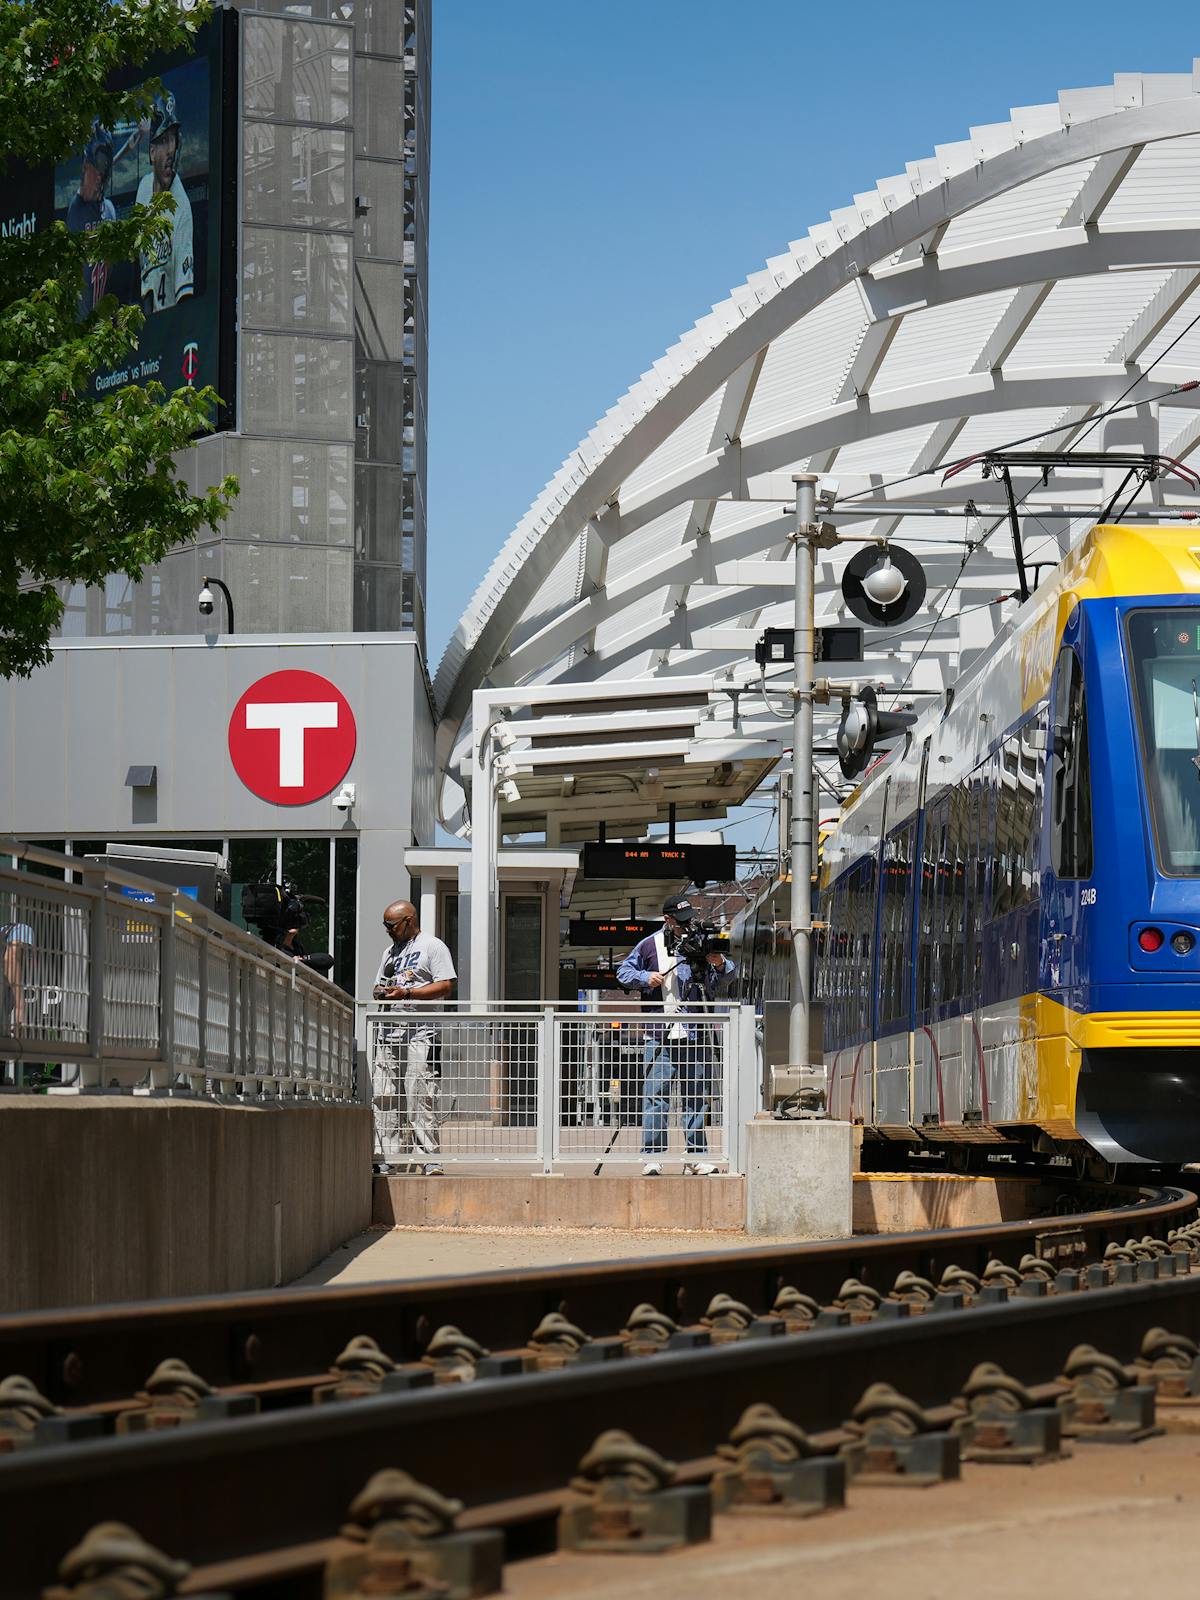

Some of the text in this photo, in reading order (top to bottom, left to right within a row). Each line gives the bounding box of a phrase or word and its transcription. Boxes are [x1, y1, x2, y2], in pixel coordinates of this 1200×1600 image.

[95, 359, 160, 391] Guardians vs Twins
[246, 702, 338, 787] T
[661, 851, 679, 859] TRACK
[1081, 888, 1096, 905] 224B
